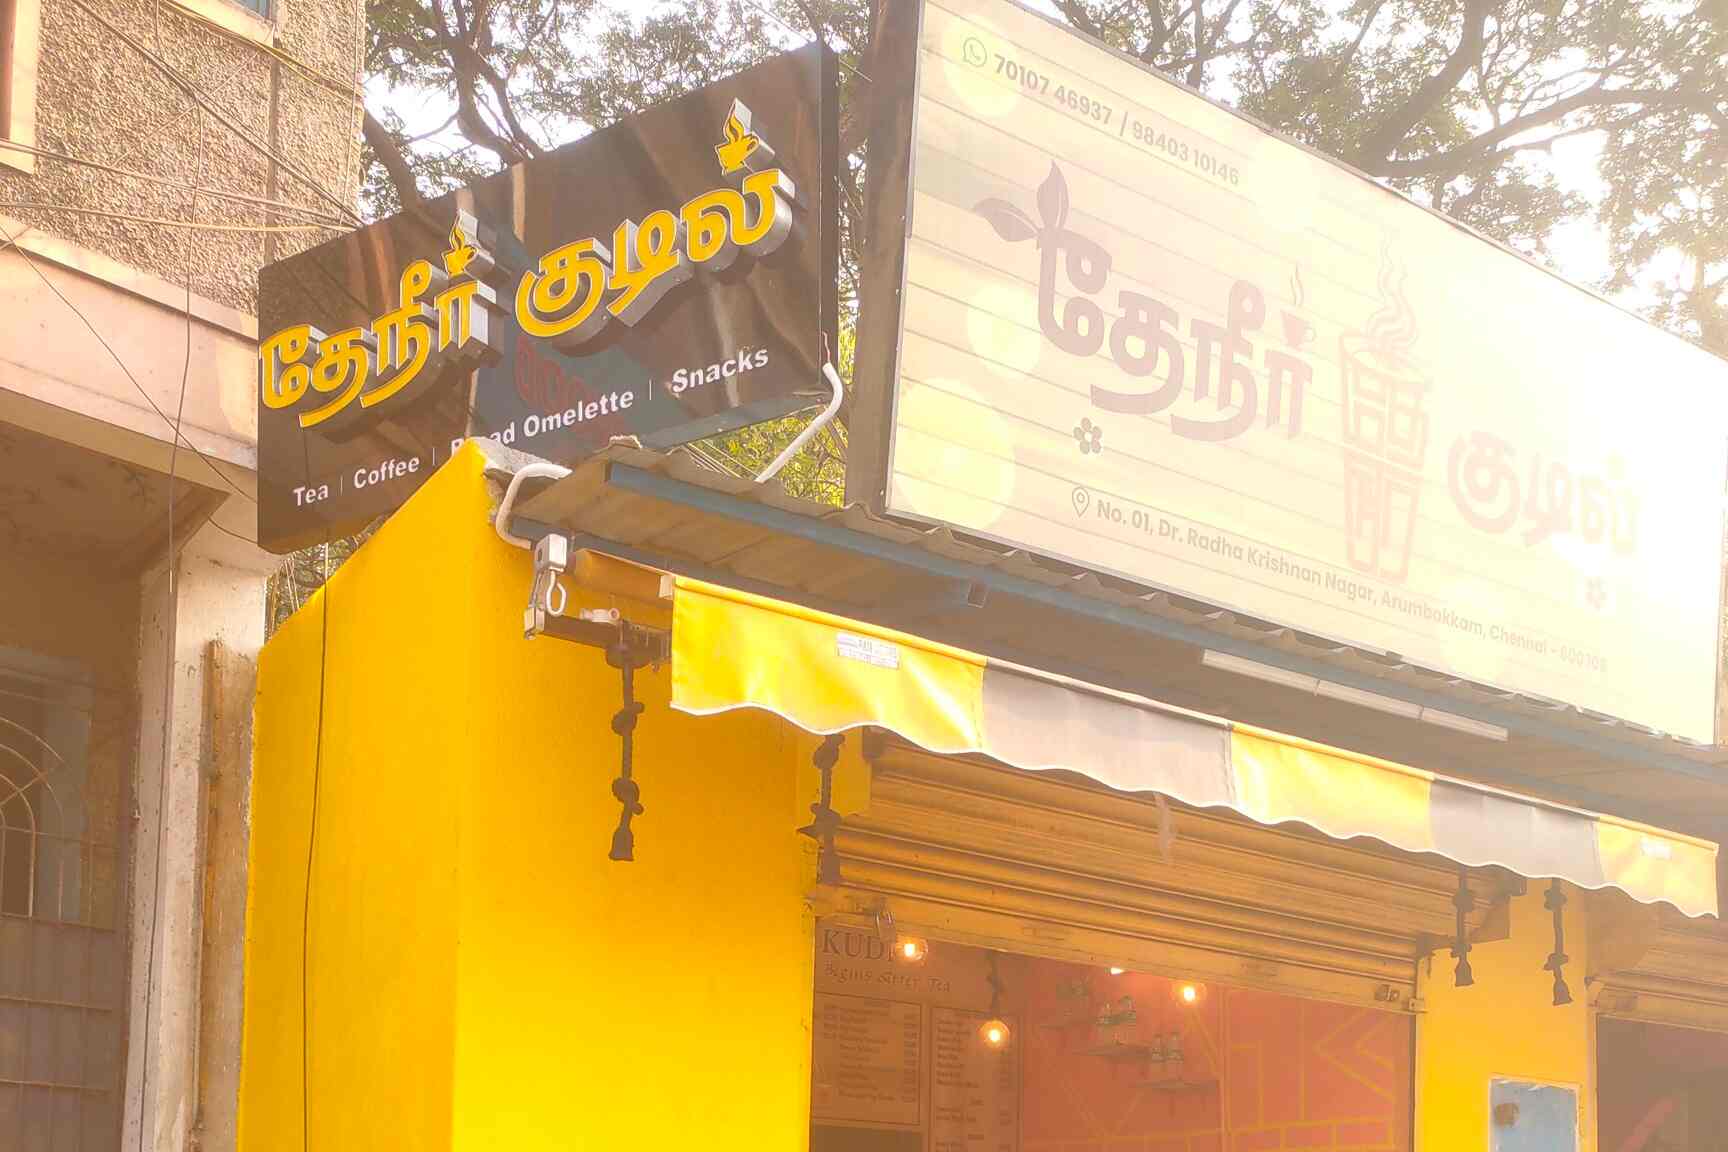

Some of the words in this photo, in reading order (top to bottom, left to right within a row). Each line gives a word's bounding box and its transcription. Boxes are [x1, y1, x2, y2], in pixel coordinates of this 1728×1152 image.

[993, 53, 1050, 95] 70107
[1053, 84, 1113, 125] 46937
[1131, 119, 1189, 162] 98403
[1191, 149, 1240, 187] 10146
[292, 483, 329, 507] Tea
[353, 456, 420, 489] Coffee
[451, 422, 515, 456] Bad
[523, 388, 635, 438] Omelette
[671, 347, 769, 393] Snacks
[1096, 498, 1127, 526] No.
[1131, 509, 1153, 536] 01,
[1158, 519, 1184, 544] Dr.
[1187, 527, 1243, 561] Radha
[1246, 543, 1323, 586] Krishnan
[1324, 571, 1379, 606] Nagar,
